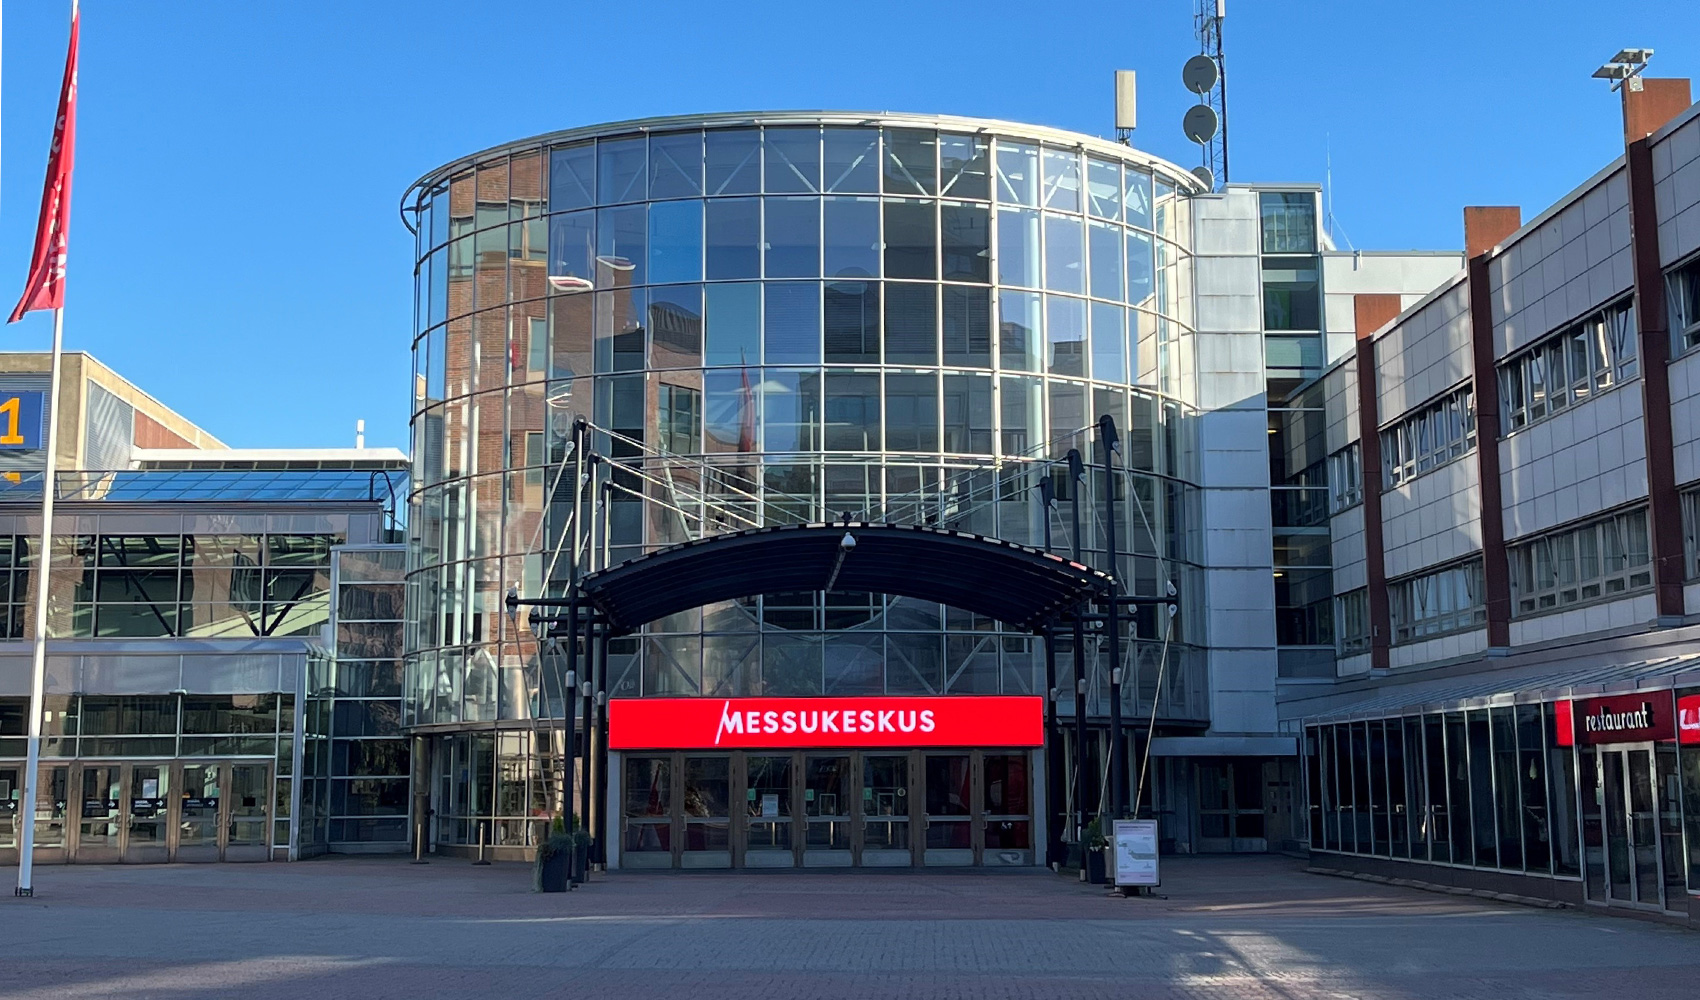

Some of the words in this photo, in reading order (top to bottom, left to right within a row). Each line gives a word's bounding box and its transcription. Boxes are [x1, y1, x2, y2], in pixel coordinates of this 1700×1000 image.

[0, 397, 24, 444] 1
[714, 700, 936, 745] MESSUKESKUS
[1585, 701, 1649, 732] restaurant
